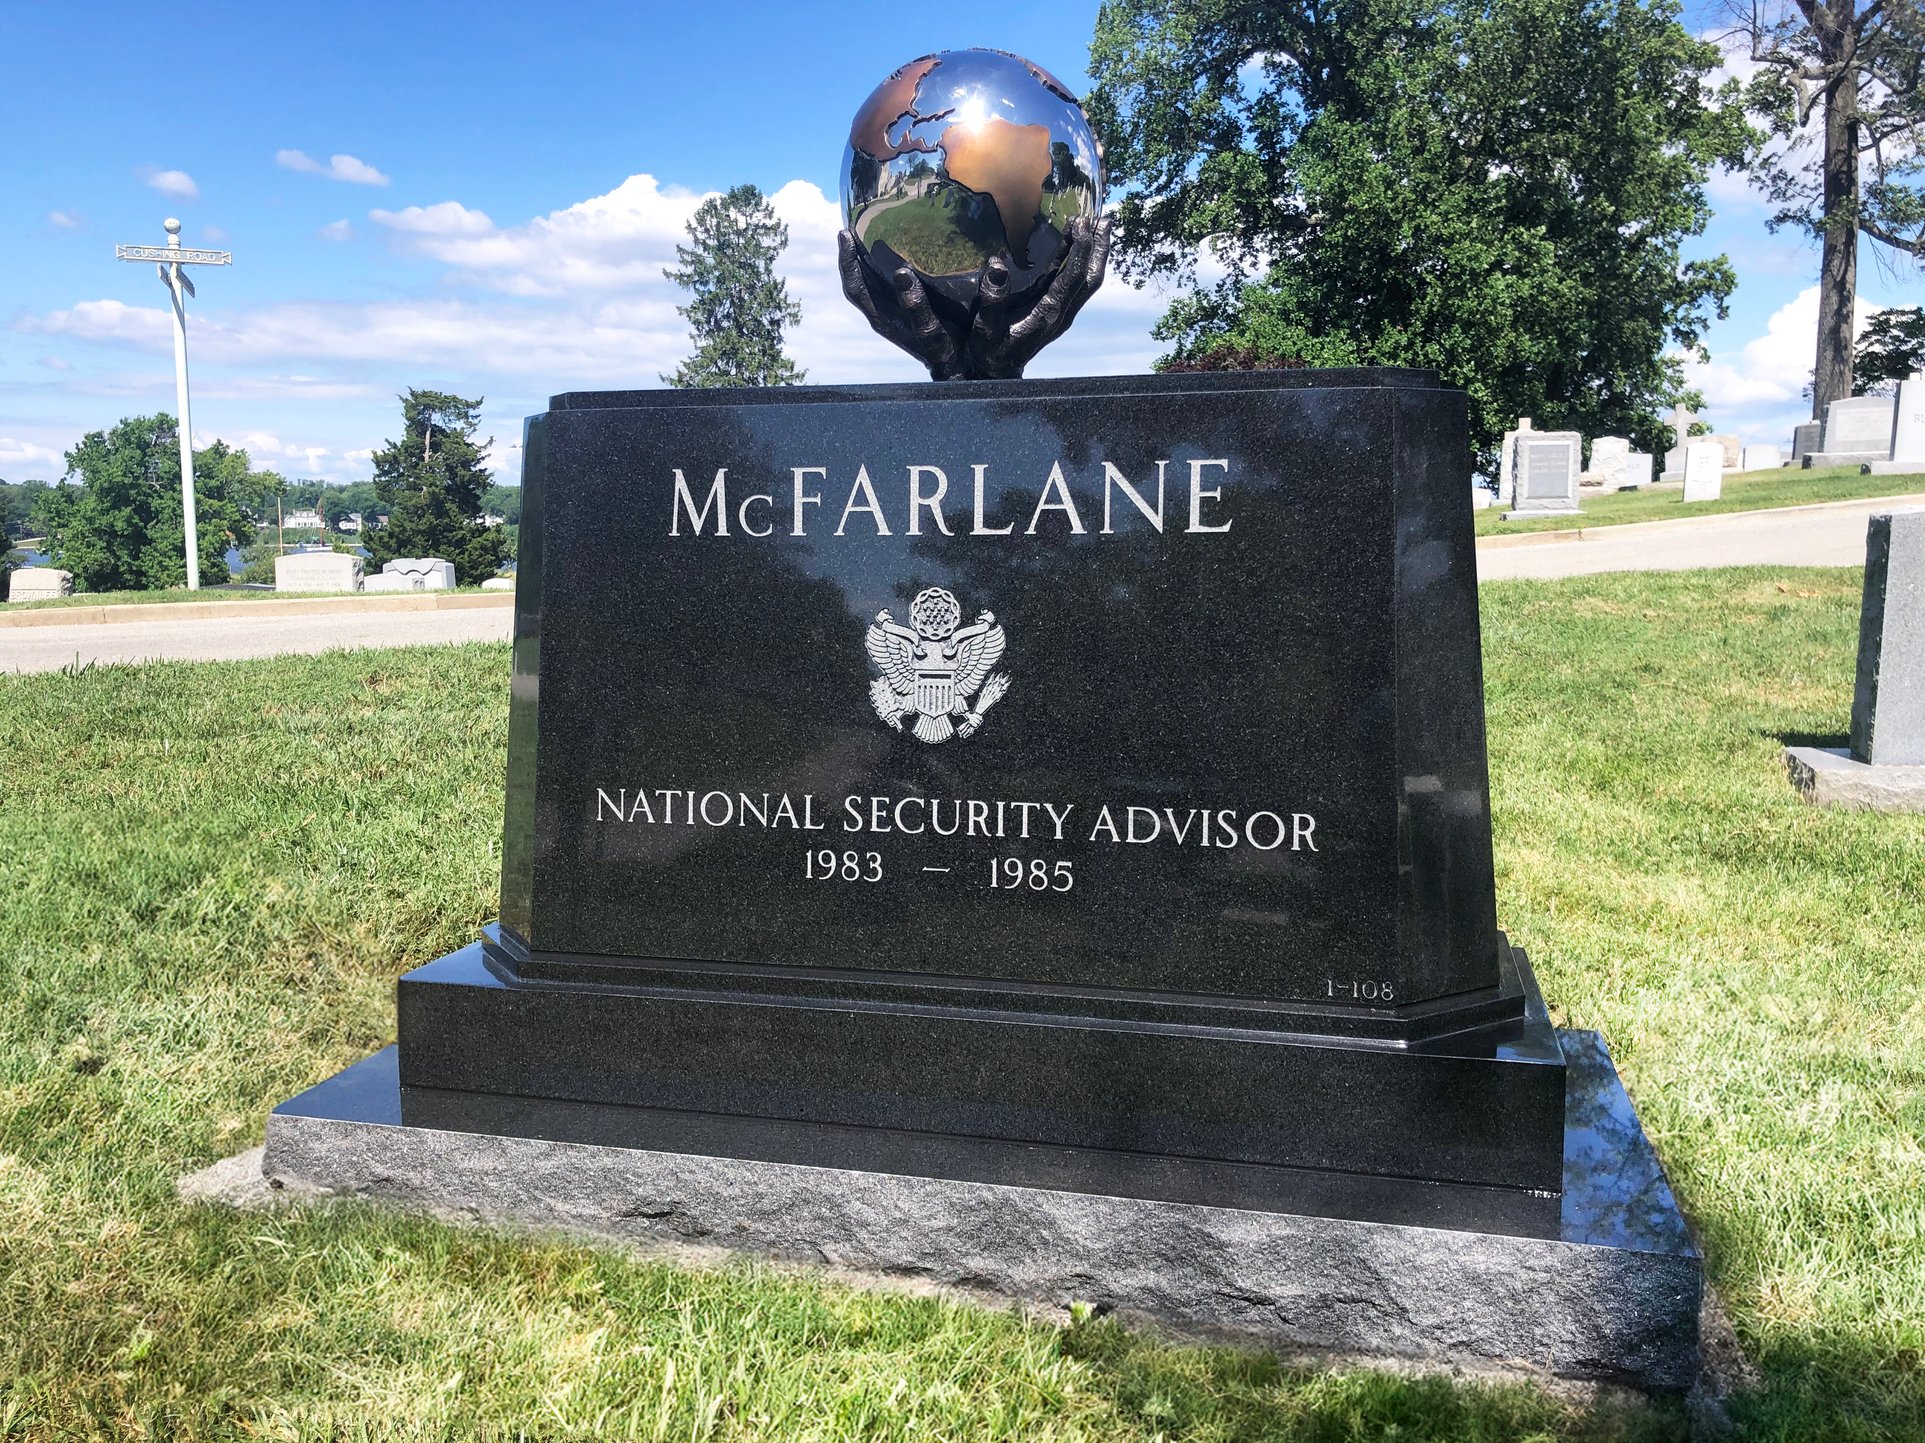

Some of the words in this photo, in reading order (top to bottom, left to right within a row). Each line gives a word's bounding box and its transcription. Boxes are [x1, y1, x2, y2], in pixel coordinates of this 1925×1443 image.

[133, 249, 180, 259] CUSHING
[186, 252, 216, 260] ROAD
[597, 788, 824, 830] NATIONAL
[844, 796, 1074, 839] SECURITY
[1089, 805, 1319, 852] ADVISOR
[806, 850, 883, 882] 1983
[991, 858, 1073, 892] 1985
[1327, 979, 1394, 1001] 1-108
